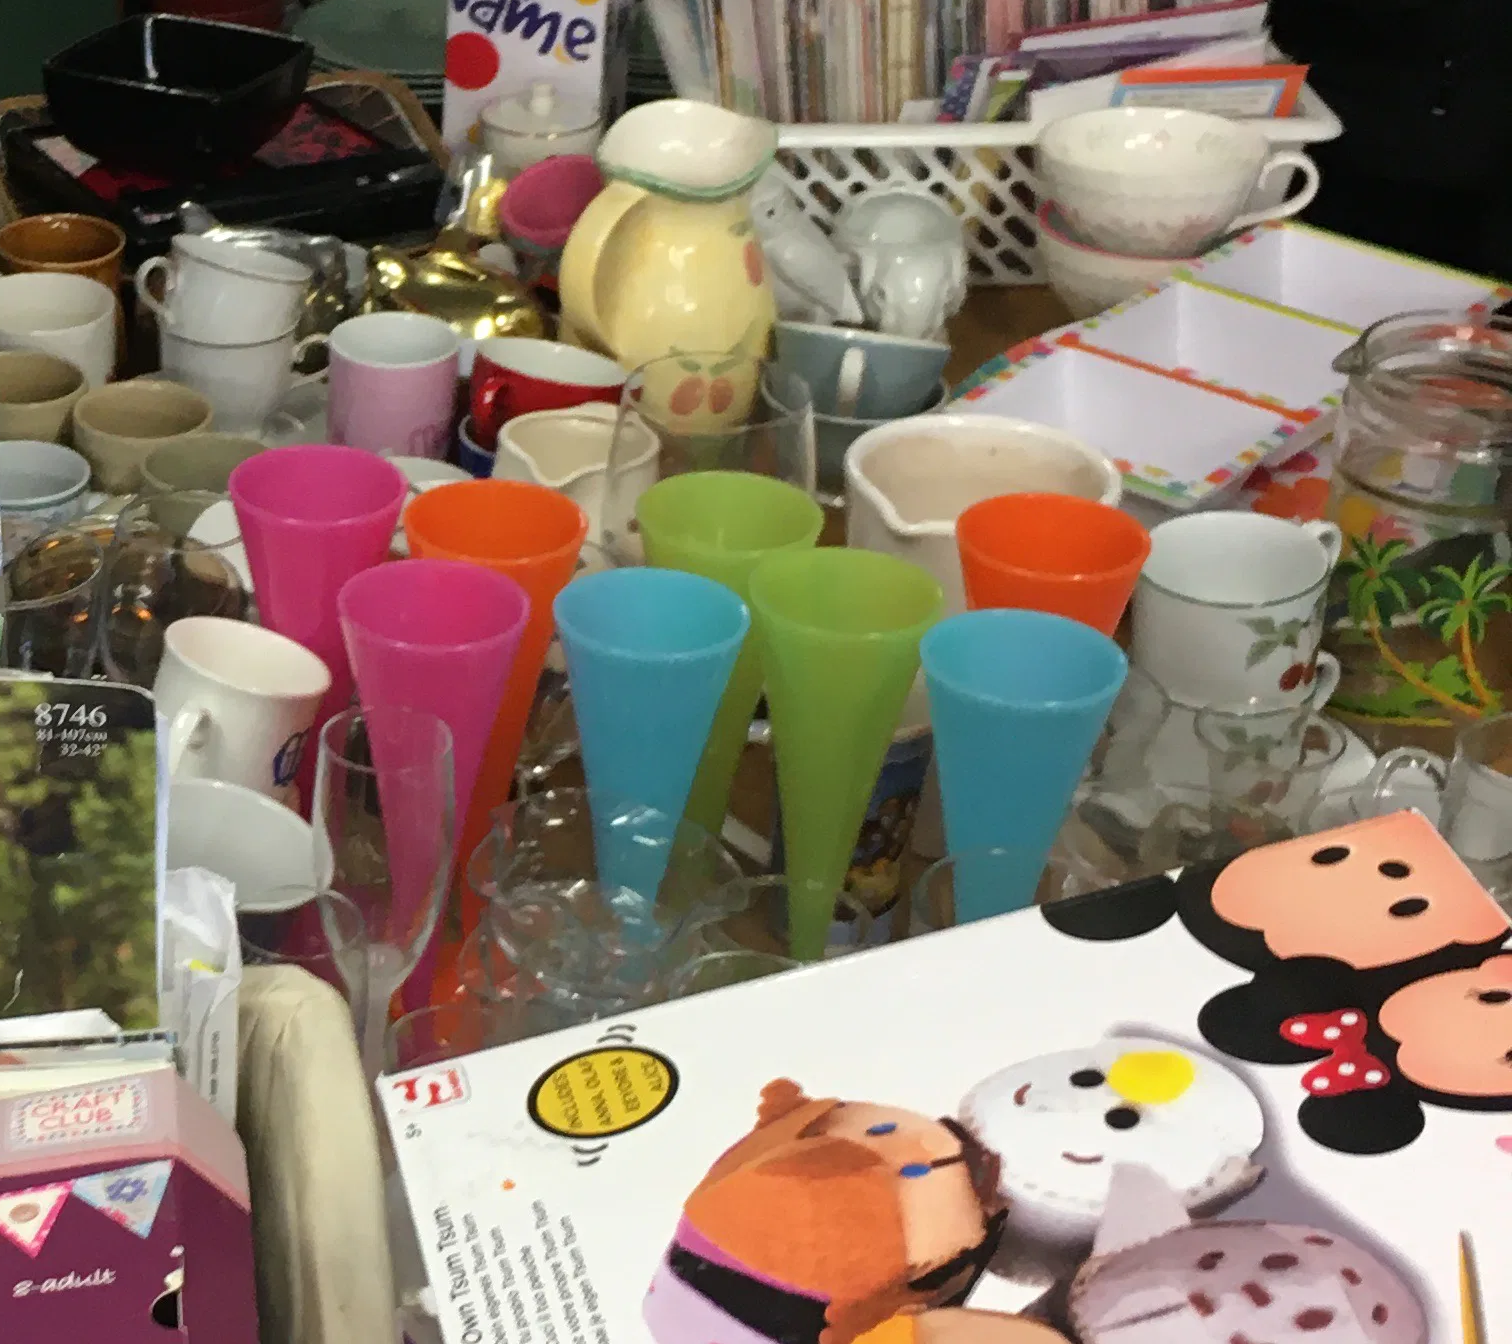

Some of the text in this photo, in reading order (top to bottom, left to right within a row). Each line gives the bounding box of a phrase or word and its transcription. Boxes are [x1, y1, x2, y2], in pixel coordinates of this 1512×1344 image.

[34, 702, 107, 728] 8746
[30, 1086, 126, 1118] CRAFT
[37, 1107, 114, 1130] CLUB
[433, 1205, 458, 1253] Tsum
[445, 1252, 471, 1303] Tsum
